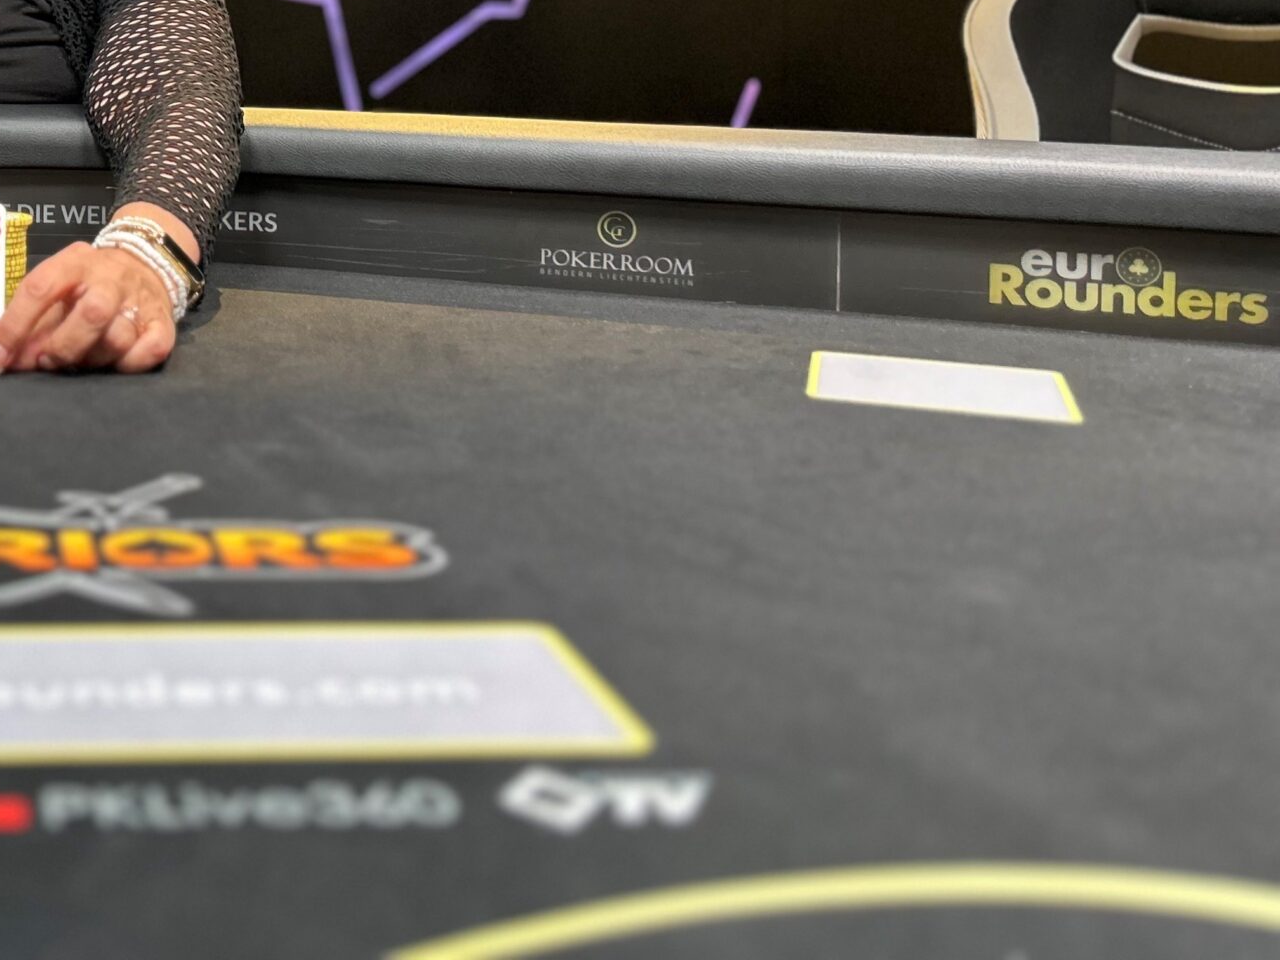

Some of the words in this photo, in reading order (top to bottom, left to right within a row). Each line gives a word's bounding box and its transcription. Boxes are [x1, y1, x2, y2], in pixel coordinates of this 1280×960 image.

[539, 267, 593, 279] BENDERN
[600, 270, 694, 287] LIECHTENSTEIN
[989, 253, 1269, 325] Rounders
